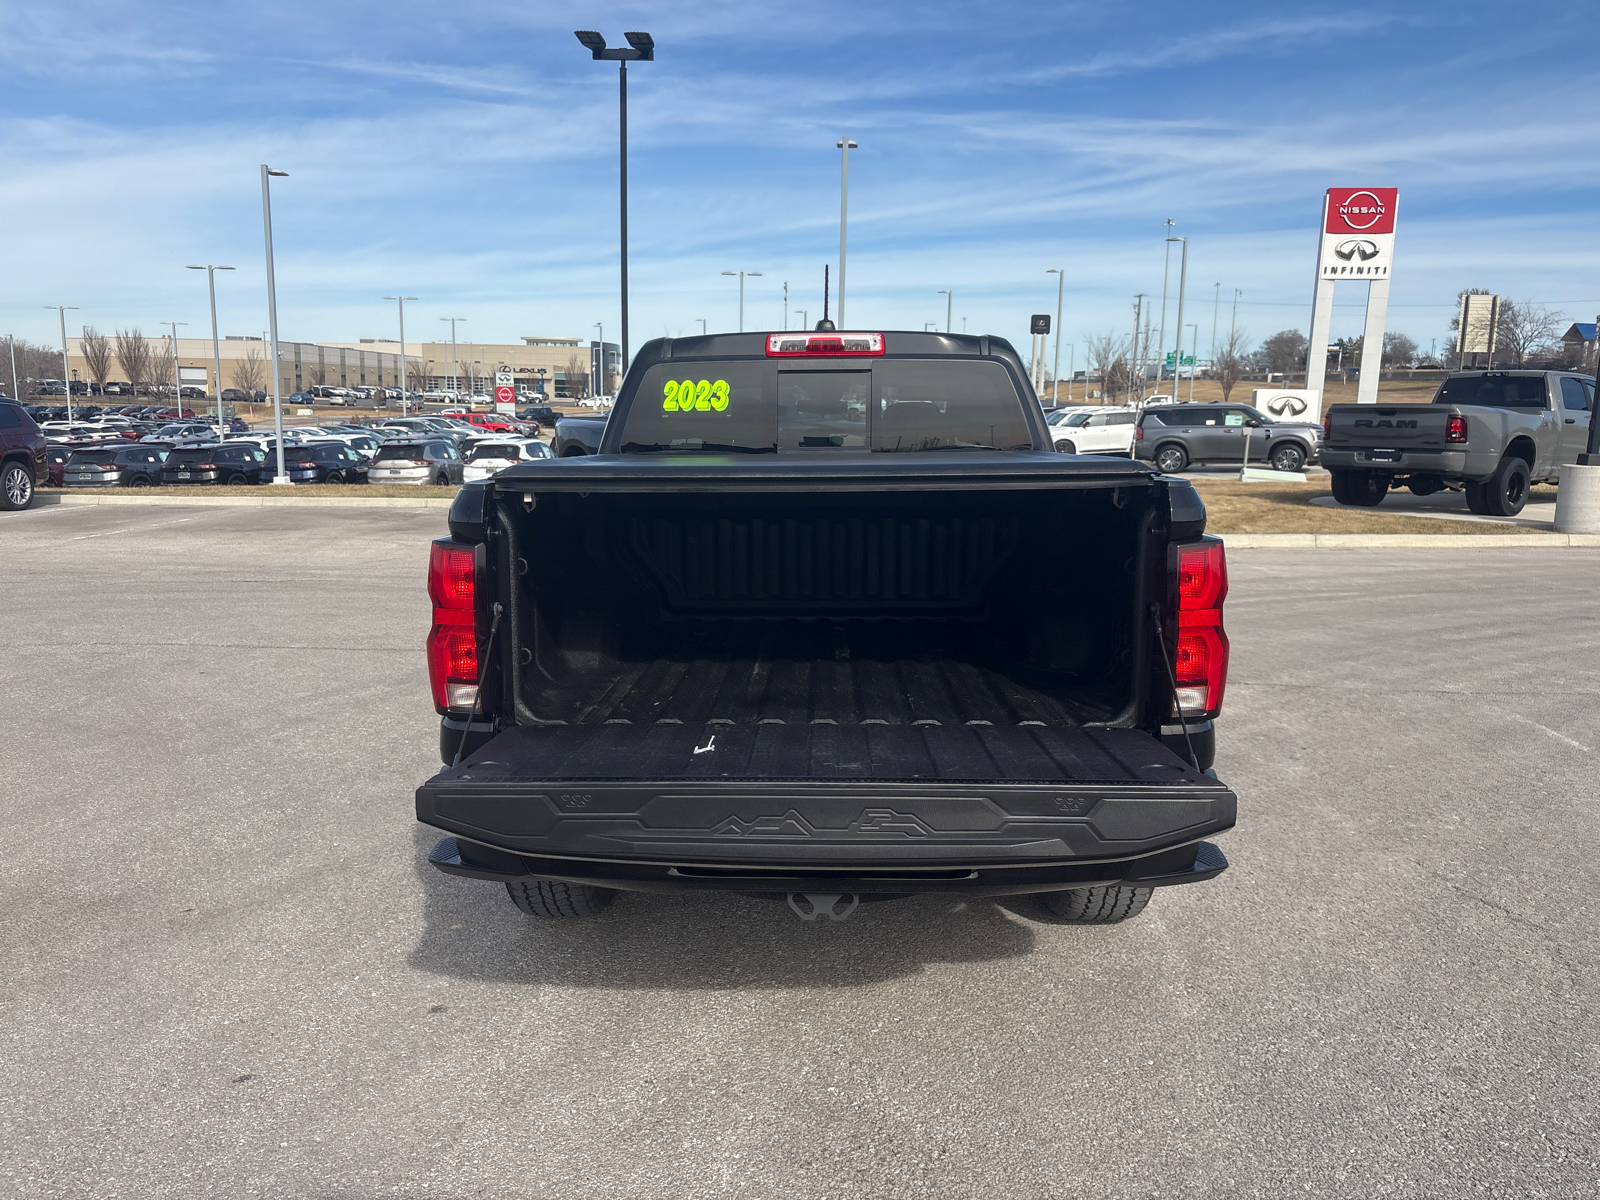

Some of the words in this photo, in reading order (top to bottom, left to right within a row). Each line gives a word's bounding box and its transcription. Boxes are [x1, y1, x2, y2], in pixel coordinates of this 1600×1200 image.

[1323, 266, 1388, 275] INFINITI
[663, 380, 730, 411] 2023
[1354, 420, 1418, 429] RAM
